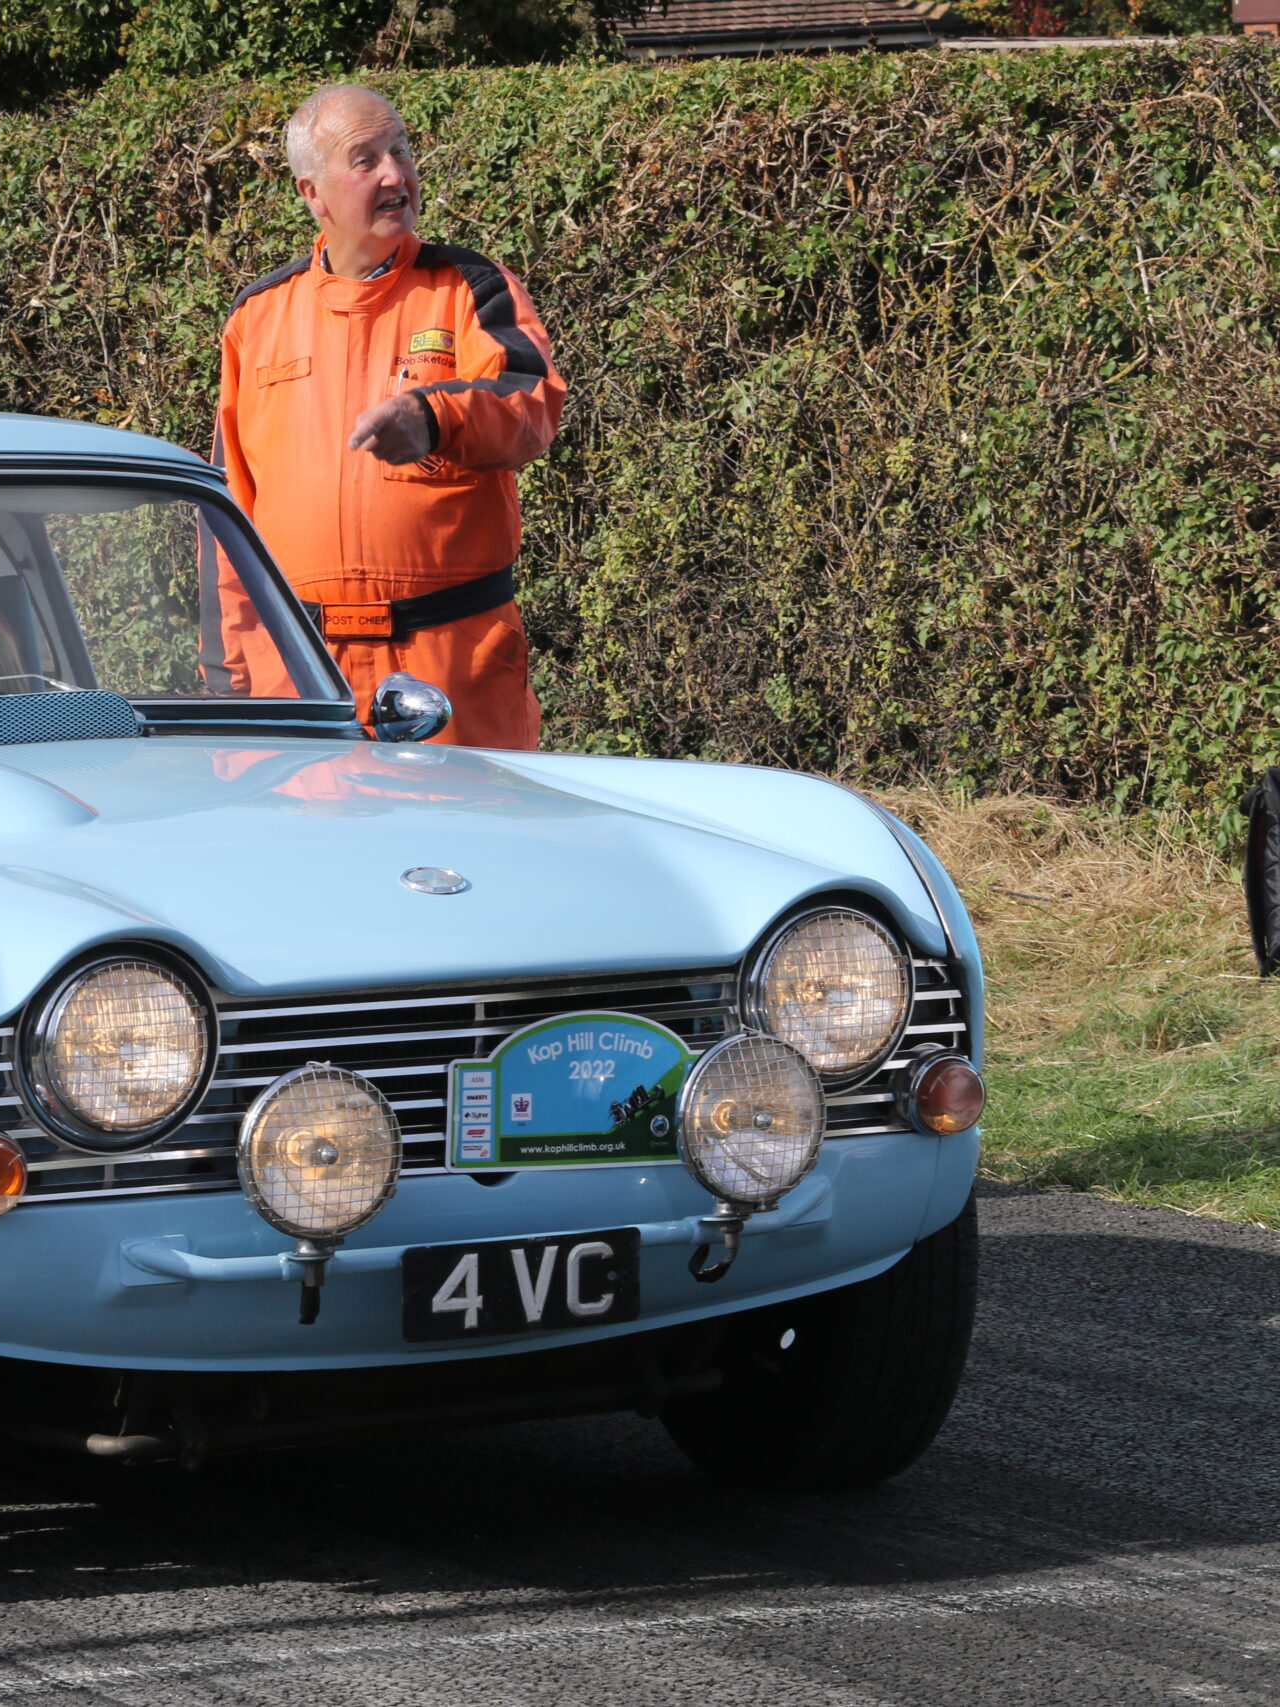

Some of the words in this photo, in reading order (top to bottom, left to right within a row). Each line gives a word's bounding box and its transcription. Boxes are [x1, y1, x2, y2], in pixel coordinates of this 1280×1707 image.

[395, 356, 416, 365] Bob
[325, 616, 353, 625] POST
[358, 615, 388, 625] CHIEF
[527, 1041, 563, 1065] Kop
[567, 1032, 594, 1052] Hill
[599, 1032, 654, 1059] Climb
[568, 1060, 615, 1080] 2022
[520, 1141, 626, 1154] www.kophillclimb.org.uk
[432, 1253, 483, 1329] 4
[511, 1241, 615, 1323] VC
